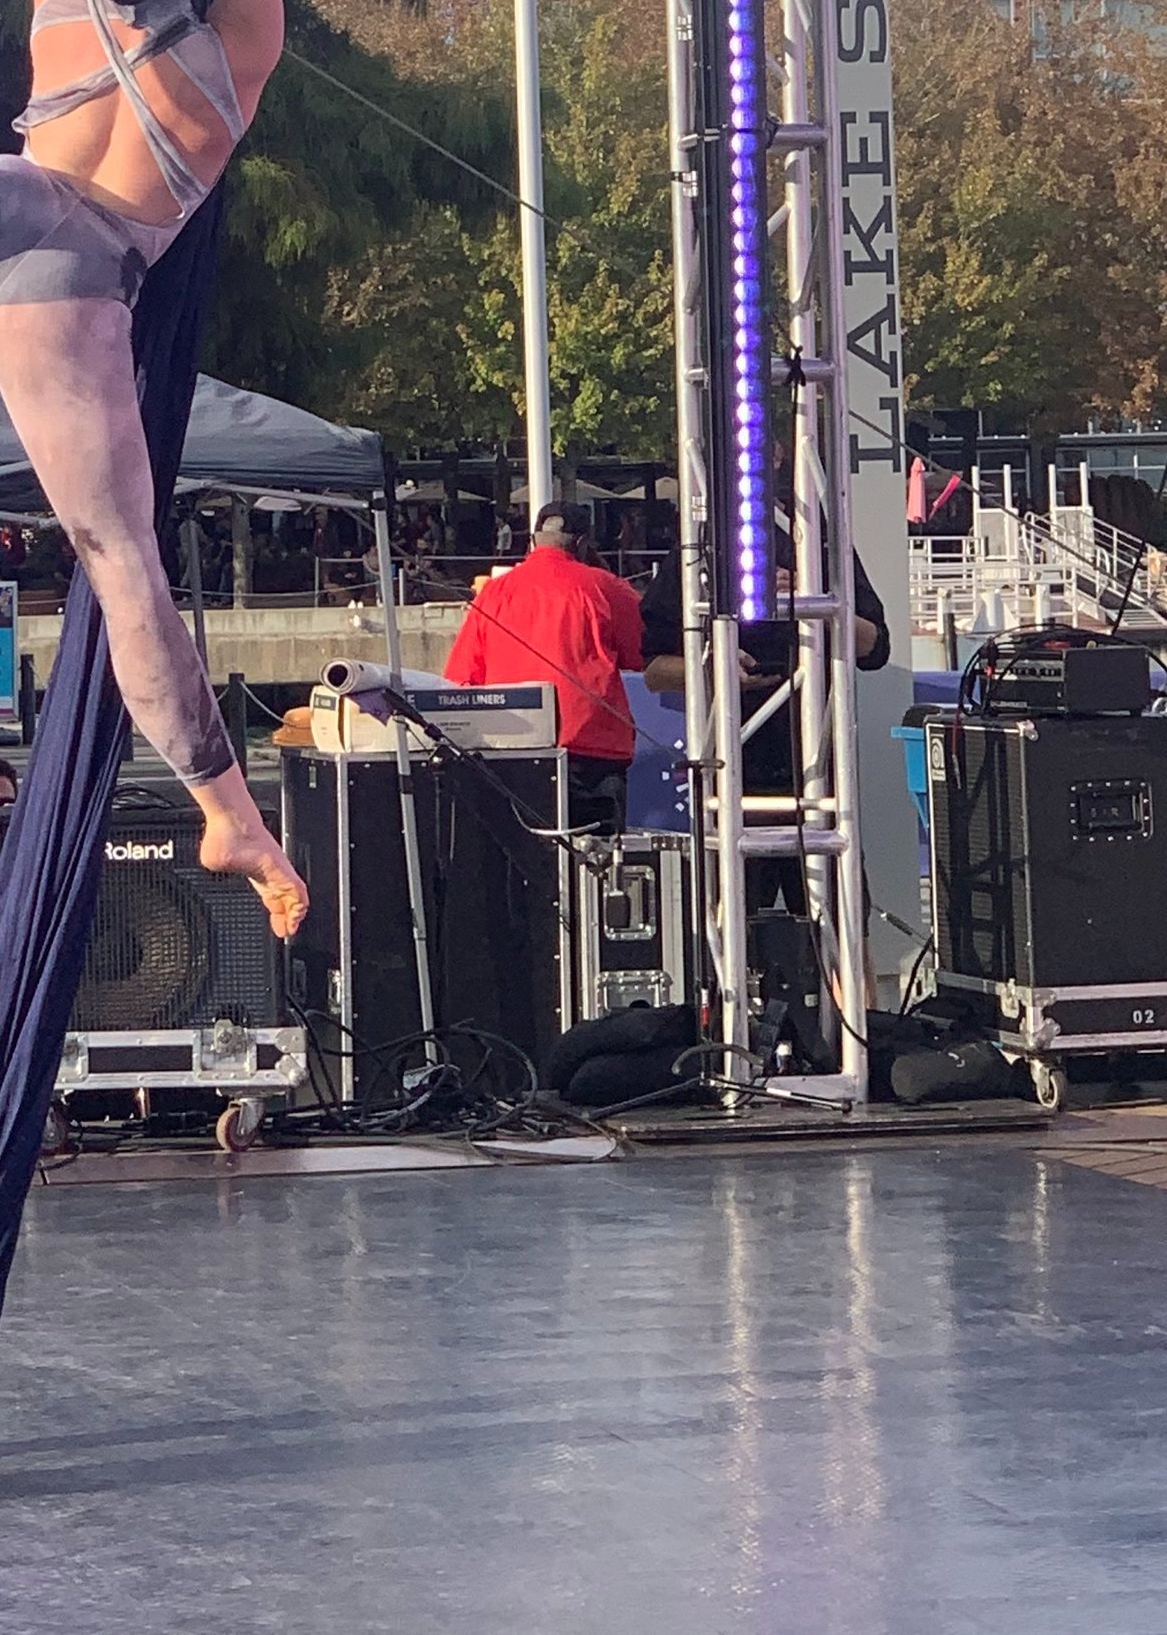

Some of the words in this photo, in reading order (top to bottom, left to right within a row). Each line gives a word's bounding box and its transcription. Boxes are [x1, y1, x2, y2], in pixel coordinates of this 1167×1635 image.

[839, 111, 901, 473] LAKE
[438, 694, 469, 705] TRASH
[472, 694, 506, 705] LINERS
[1133, 1009, 1154, 1024] 02
